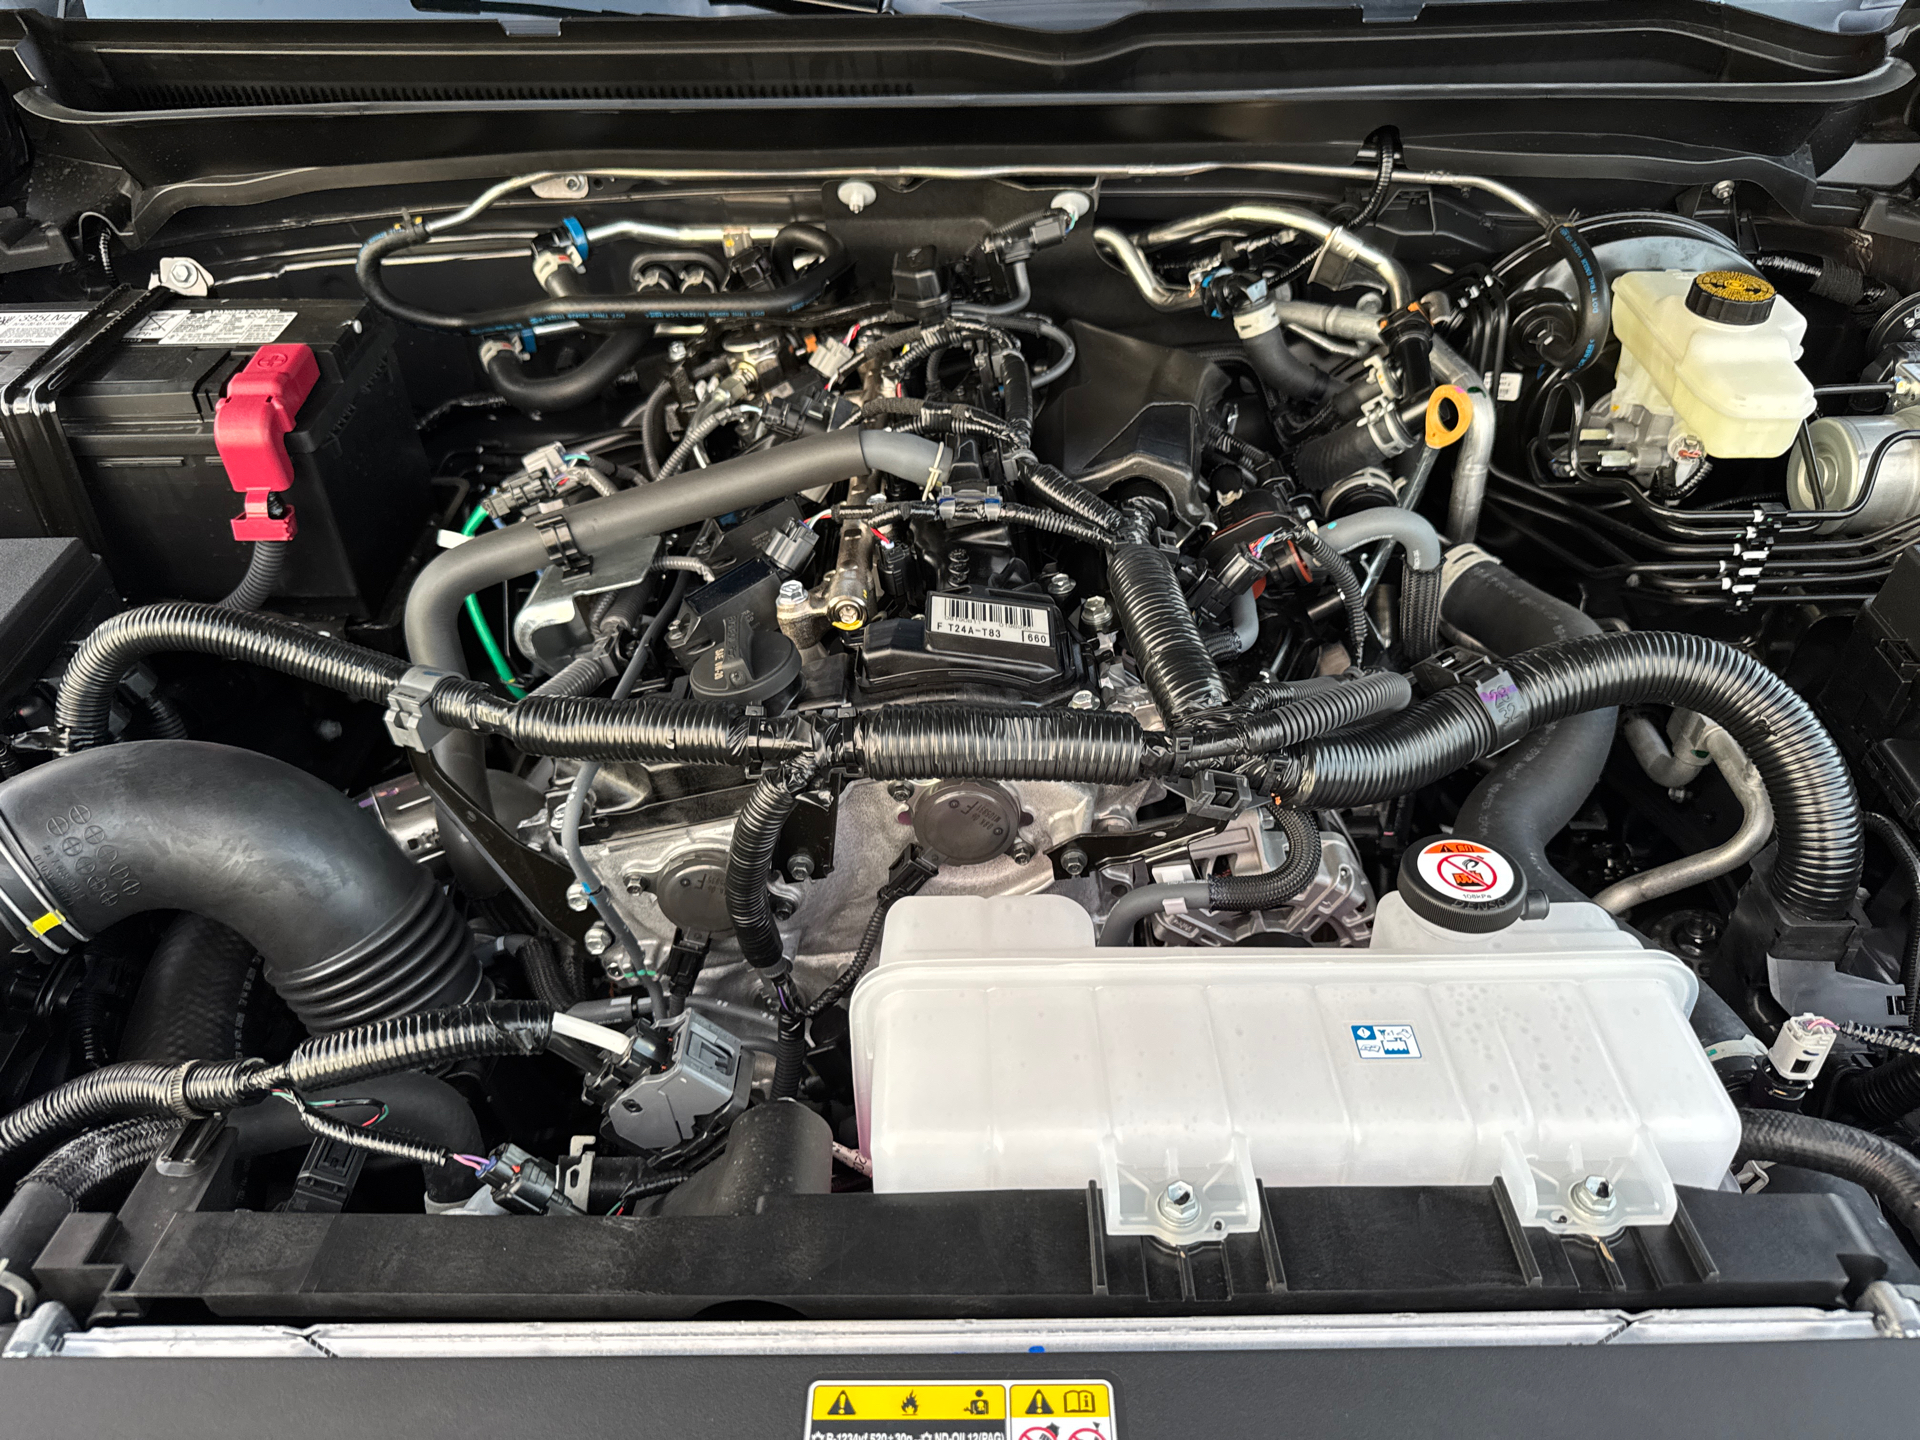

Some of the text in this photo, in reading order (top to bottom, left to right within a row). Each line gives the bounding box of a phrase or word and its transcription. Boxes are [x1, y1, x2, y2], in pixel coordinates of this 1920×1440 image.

[936, 622, 1002, 638] F T24A-T83
[1027, 634, 1047, 644] 660
[1452, 897, 1509, 912] DENSO
